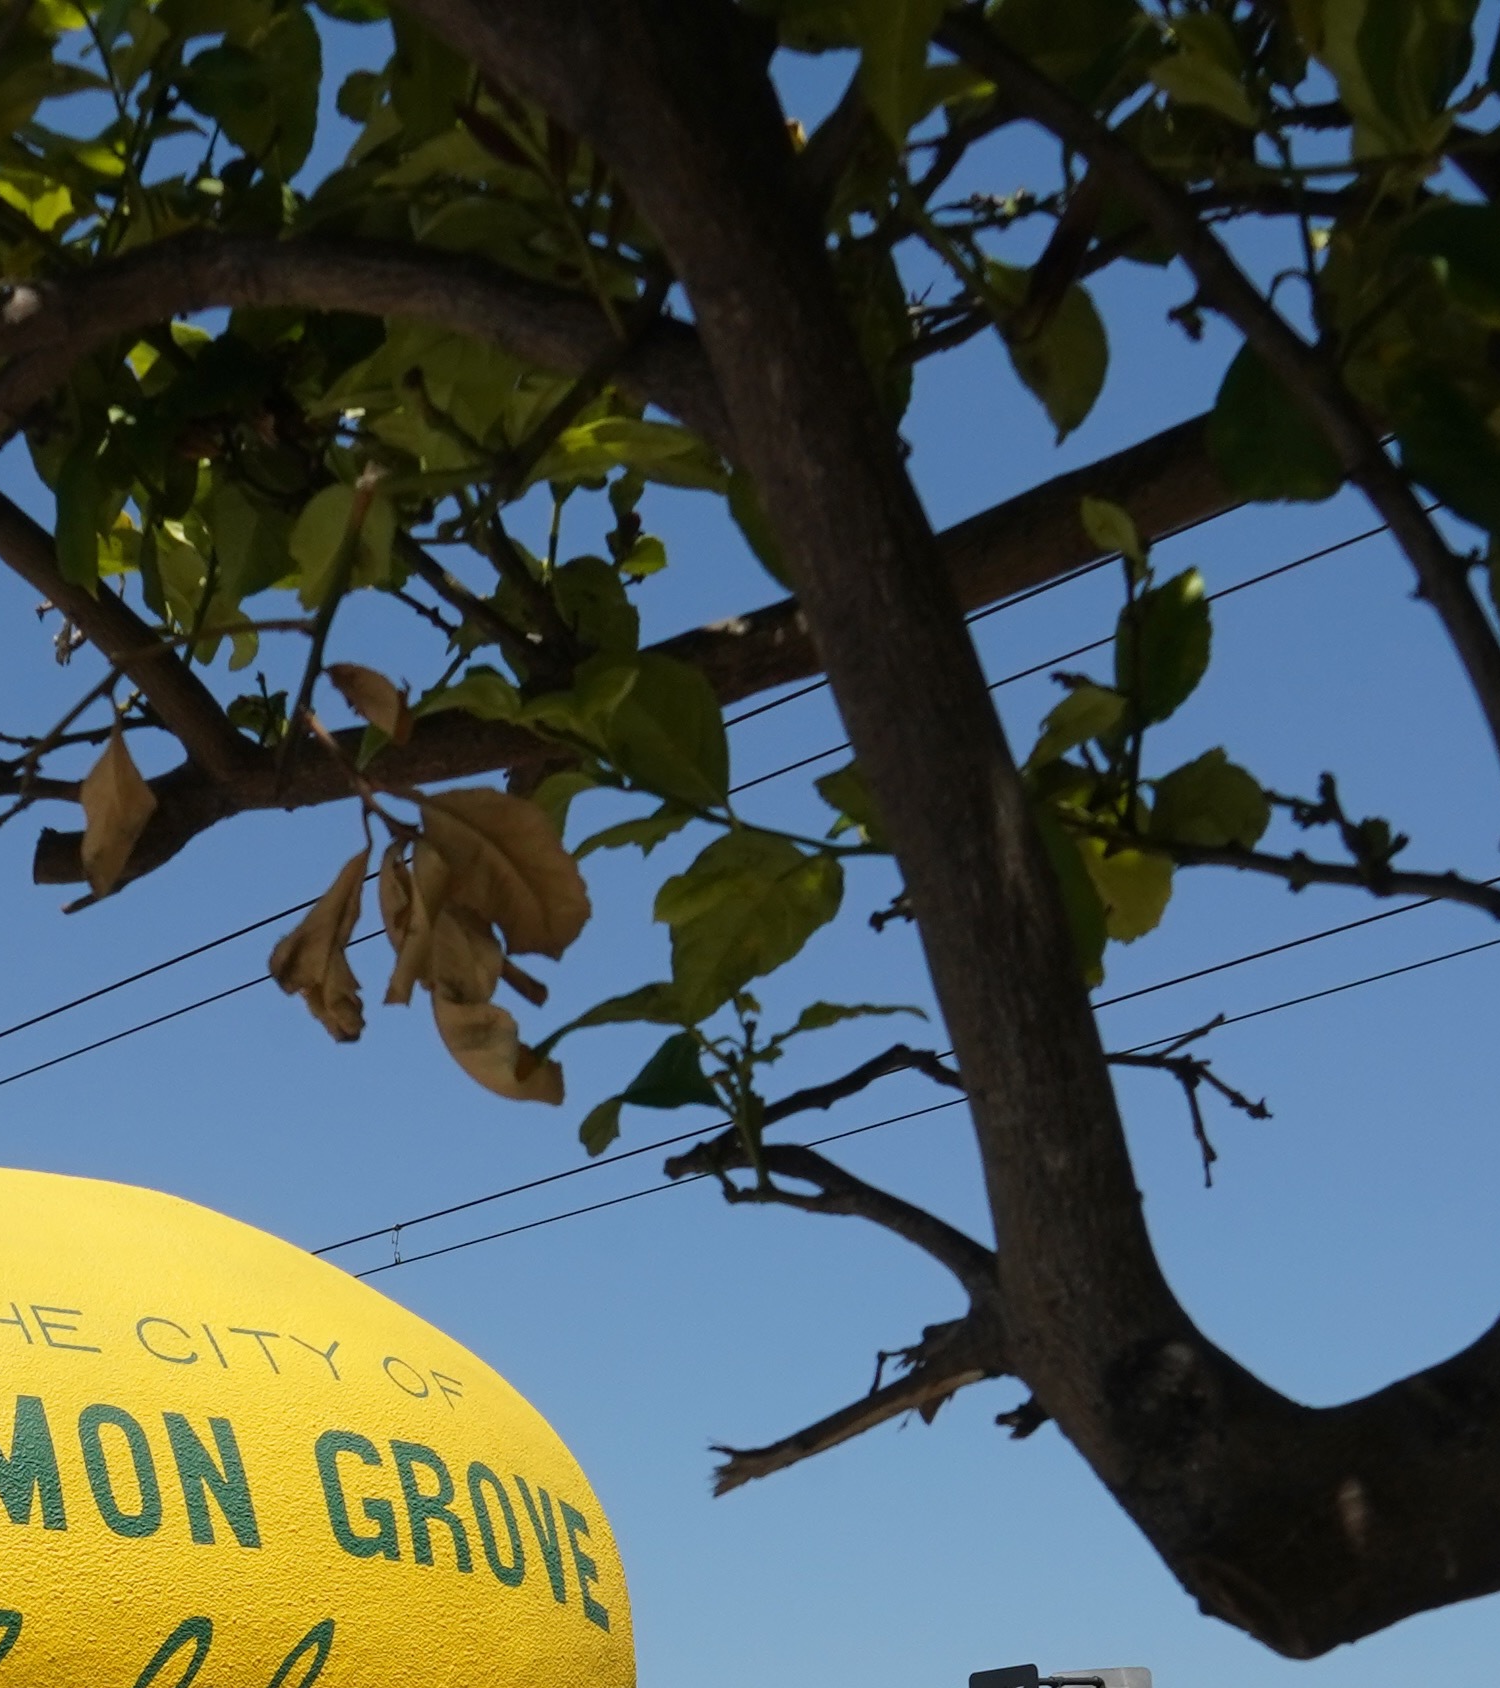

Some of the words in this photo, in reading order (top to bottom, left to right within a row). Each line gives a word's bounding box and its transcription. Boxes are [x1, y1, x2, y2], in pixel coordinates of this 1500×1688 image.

[135, 1317, 341, 1383] CITY
[381, 1354, 463, 1411] OF
[313, 1428, 610, 1633] GROVE
